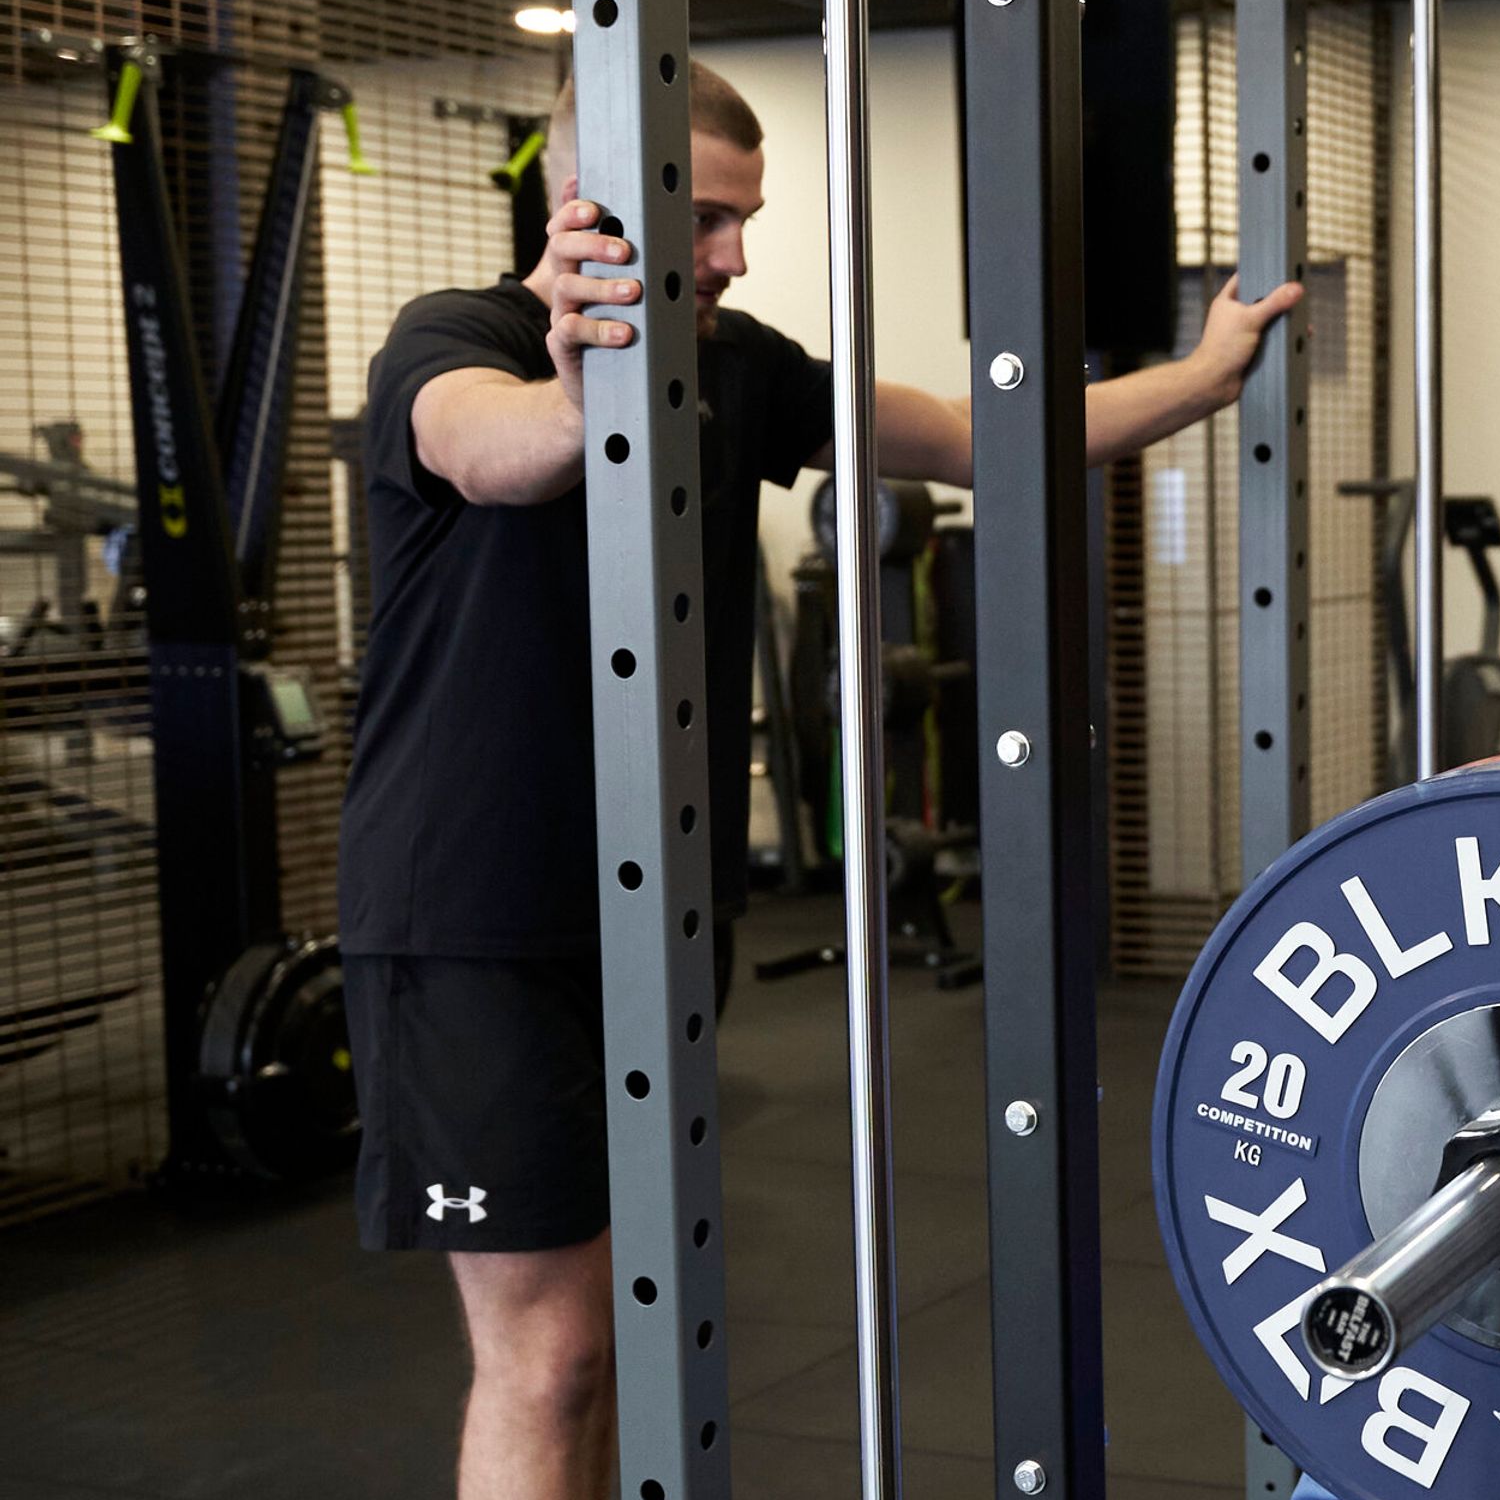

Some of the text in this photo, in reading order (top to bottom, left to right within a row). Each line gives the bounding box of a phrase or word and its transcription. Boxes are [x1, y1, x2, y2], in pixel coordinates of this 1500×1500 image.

[1221, 1040, 1306, 1119] 20
[1197, 1103, 1312, 1151] COMPETITION
[1234, 1139, 1261, 1166] KG
